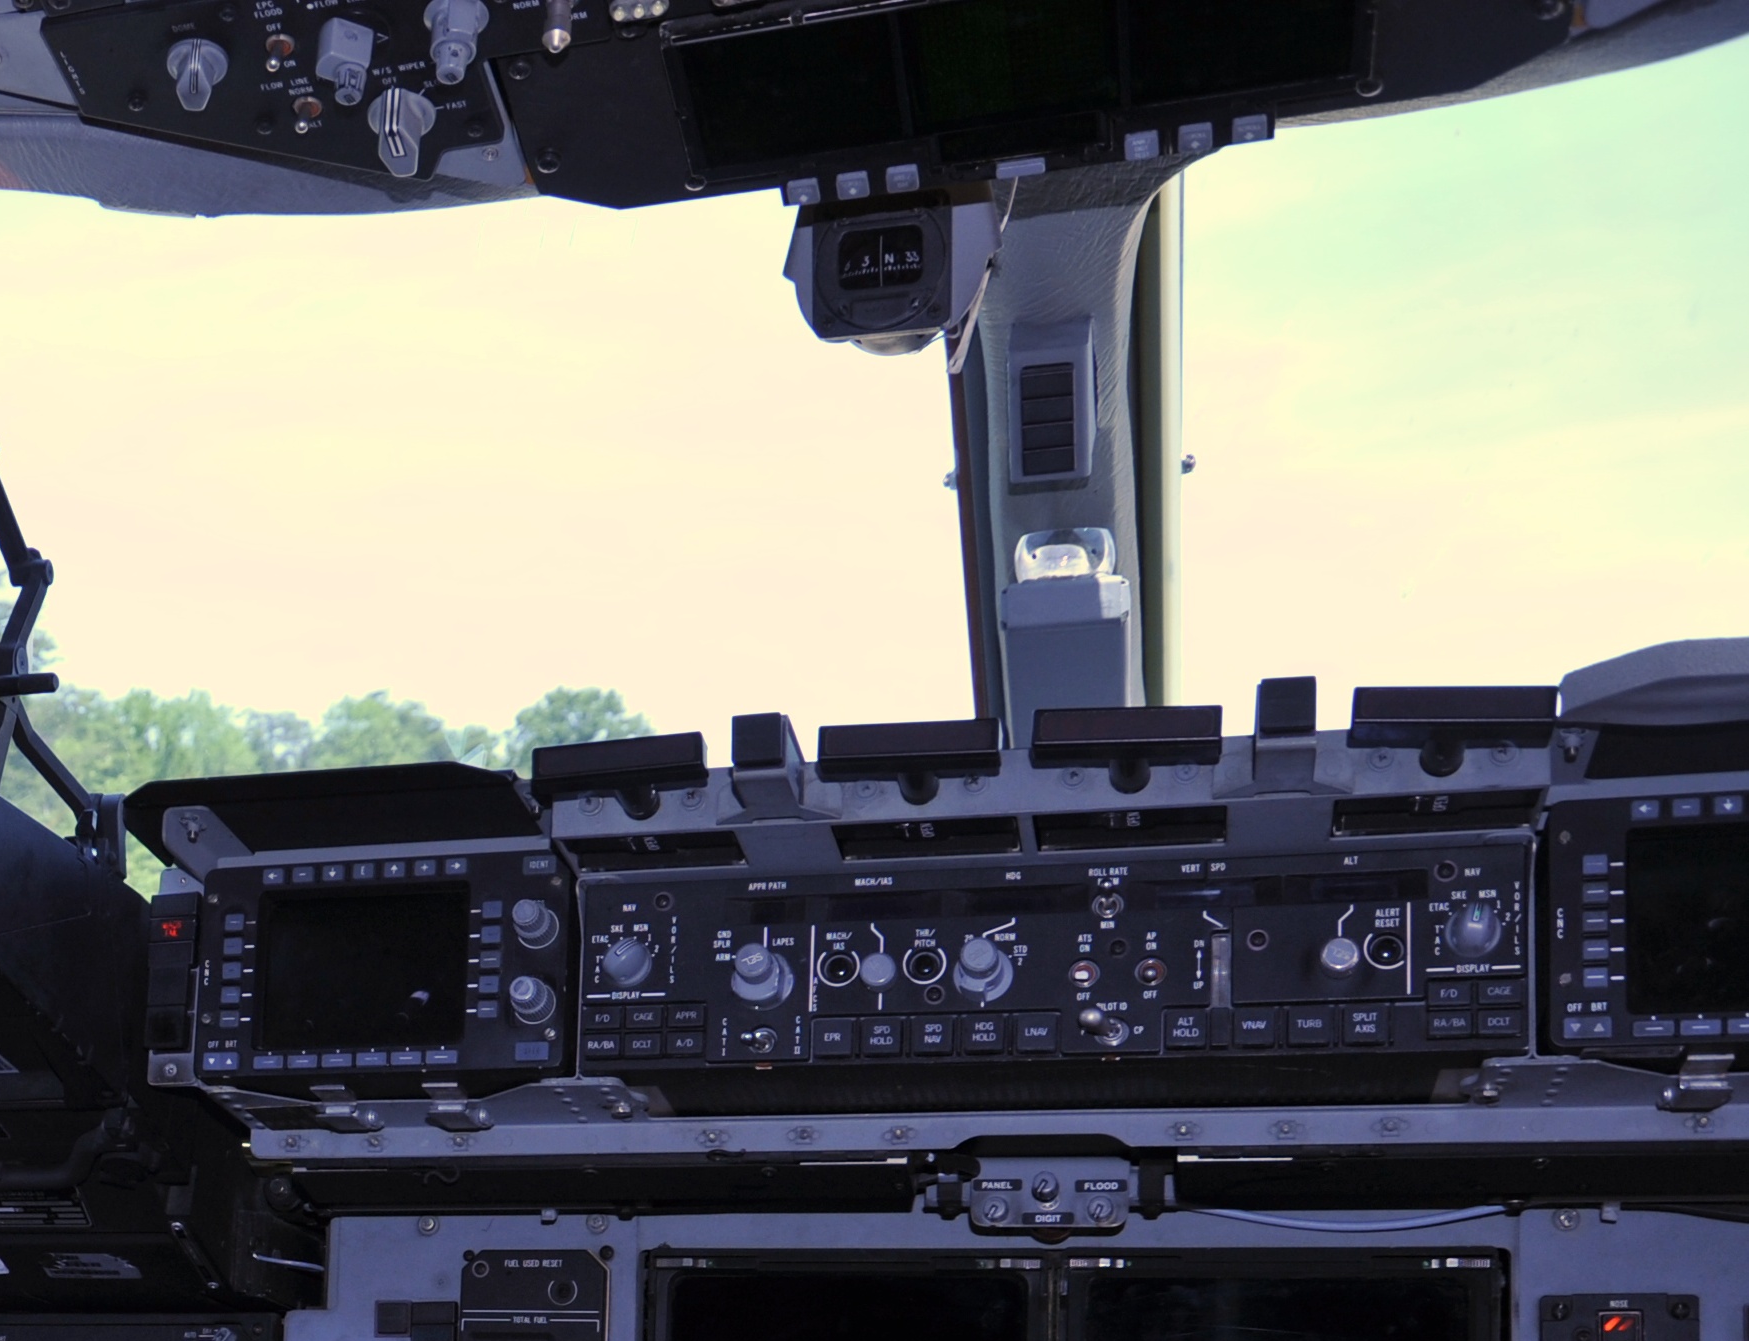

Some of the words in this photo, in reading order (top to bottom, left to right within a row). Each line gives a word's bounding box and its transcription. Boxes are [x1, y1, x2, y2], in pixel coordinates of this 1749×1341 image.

[266, 23, 282, 31] OFF
[885, 253, 894, 264] N
[905, 251, 919, 262] 33
[529, 859, 549, 869] IDENT
[1343, 856, 1358, 865] ALT
[1109, 867, 1128, 875] RATE
[1181, 865, 1200, 873] VERT
[1211, 863, 1226, 871] SPD
[1464, 868, 1481, 876] NAV
[1006, 872, 1021, 880] HDG
[855, 877, 893, 886] MACH/IAS
[1429, 902, 1450, 912] ETAC
[1375, 908, 1400, 917] ALERT
[1375, 918, 1400, 927] RESET
[994, 933, 1016, 941] NORM
[1146, 932, 1157, 940] AP
[713, 940, 731, 948] SPLR
[915, 938, 935, 947] PITCH
[1013, 945, 1027, 954] STD
[1456, 964, 1490, 973] DISPLAY
[1143, 991, 1158, 999] OFF
[1440, 989, 1458, 998] F/D
[1488, 986, 1511, 995] CAGE
[1077, 993, 1091, 1001] OFF
[1567, 1003, 1582, 1012] OFF
[1591, 1002, 1607, 1011] BRT
[633, 1012, 654, 1021] CAGE
[675, 1011, 697, 1019] APPR
[1353, 1013, 1377, 1022] SPLIT
[1178, 1017, 1194, 1026] ALT
[1242, 1021, 1266, 1029] VNAV
[1297, 1019, 1322, 1028] TURB
[1434, 1018, 1466, 1027] RA/BA
[1488, 1017, 1510, 1027] DCLT
[873, 1026, 890, 1035] SPD
[925, 1024, 942, 1033] SPD
[975, 1022, 994, 1031] HDG
[1355, 1024, 1376, 1033] AXIS
[1025, 1027, 1047, 1036] LNAV
[1173, 1028, 1199, 1037] HOLD
[824, 1032, 841, 1041] EPR
[870, 1036, 893, 1045] HOLD
[925, 1035, 942, 1043] NAV
[973, 1033, 996, 1042] HOLD
[588, 1041, 615, 1049] RA/BA
[633, 1040, 651, 1048] DCLT
[982, 1181, 1013, 1189] PANEL
[1084, 1182, 1119, 1190] FLOOD
[1035, 1214, 1061, 1222] DIGIT
[542, 1260, 563, 1268] RESET
